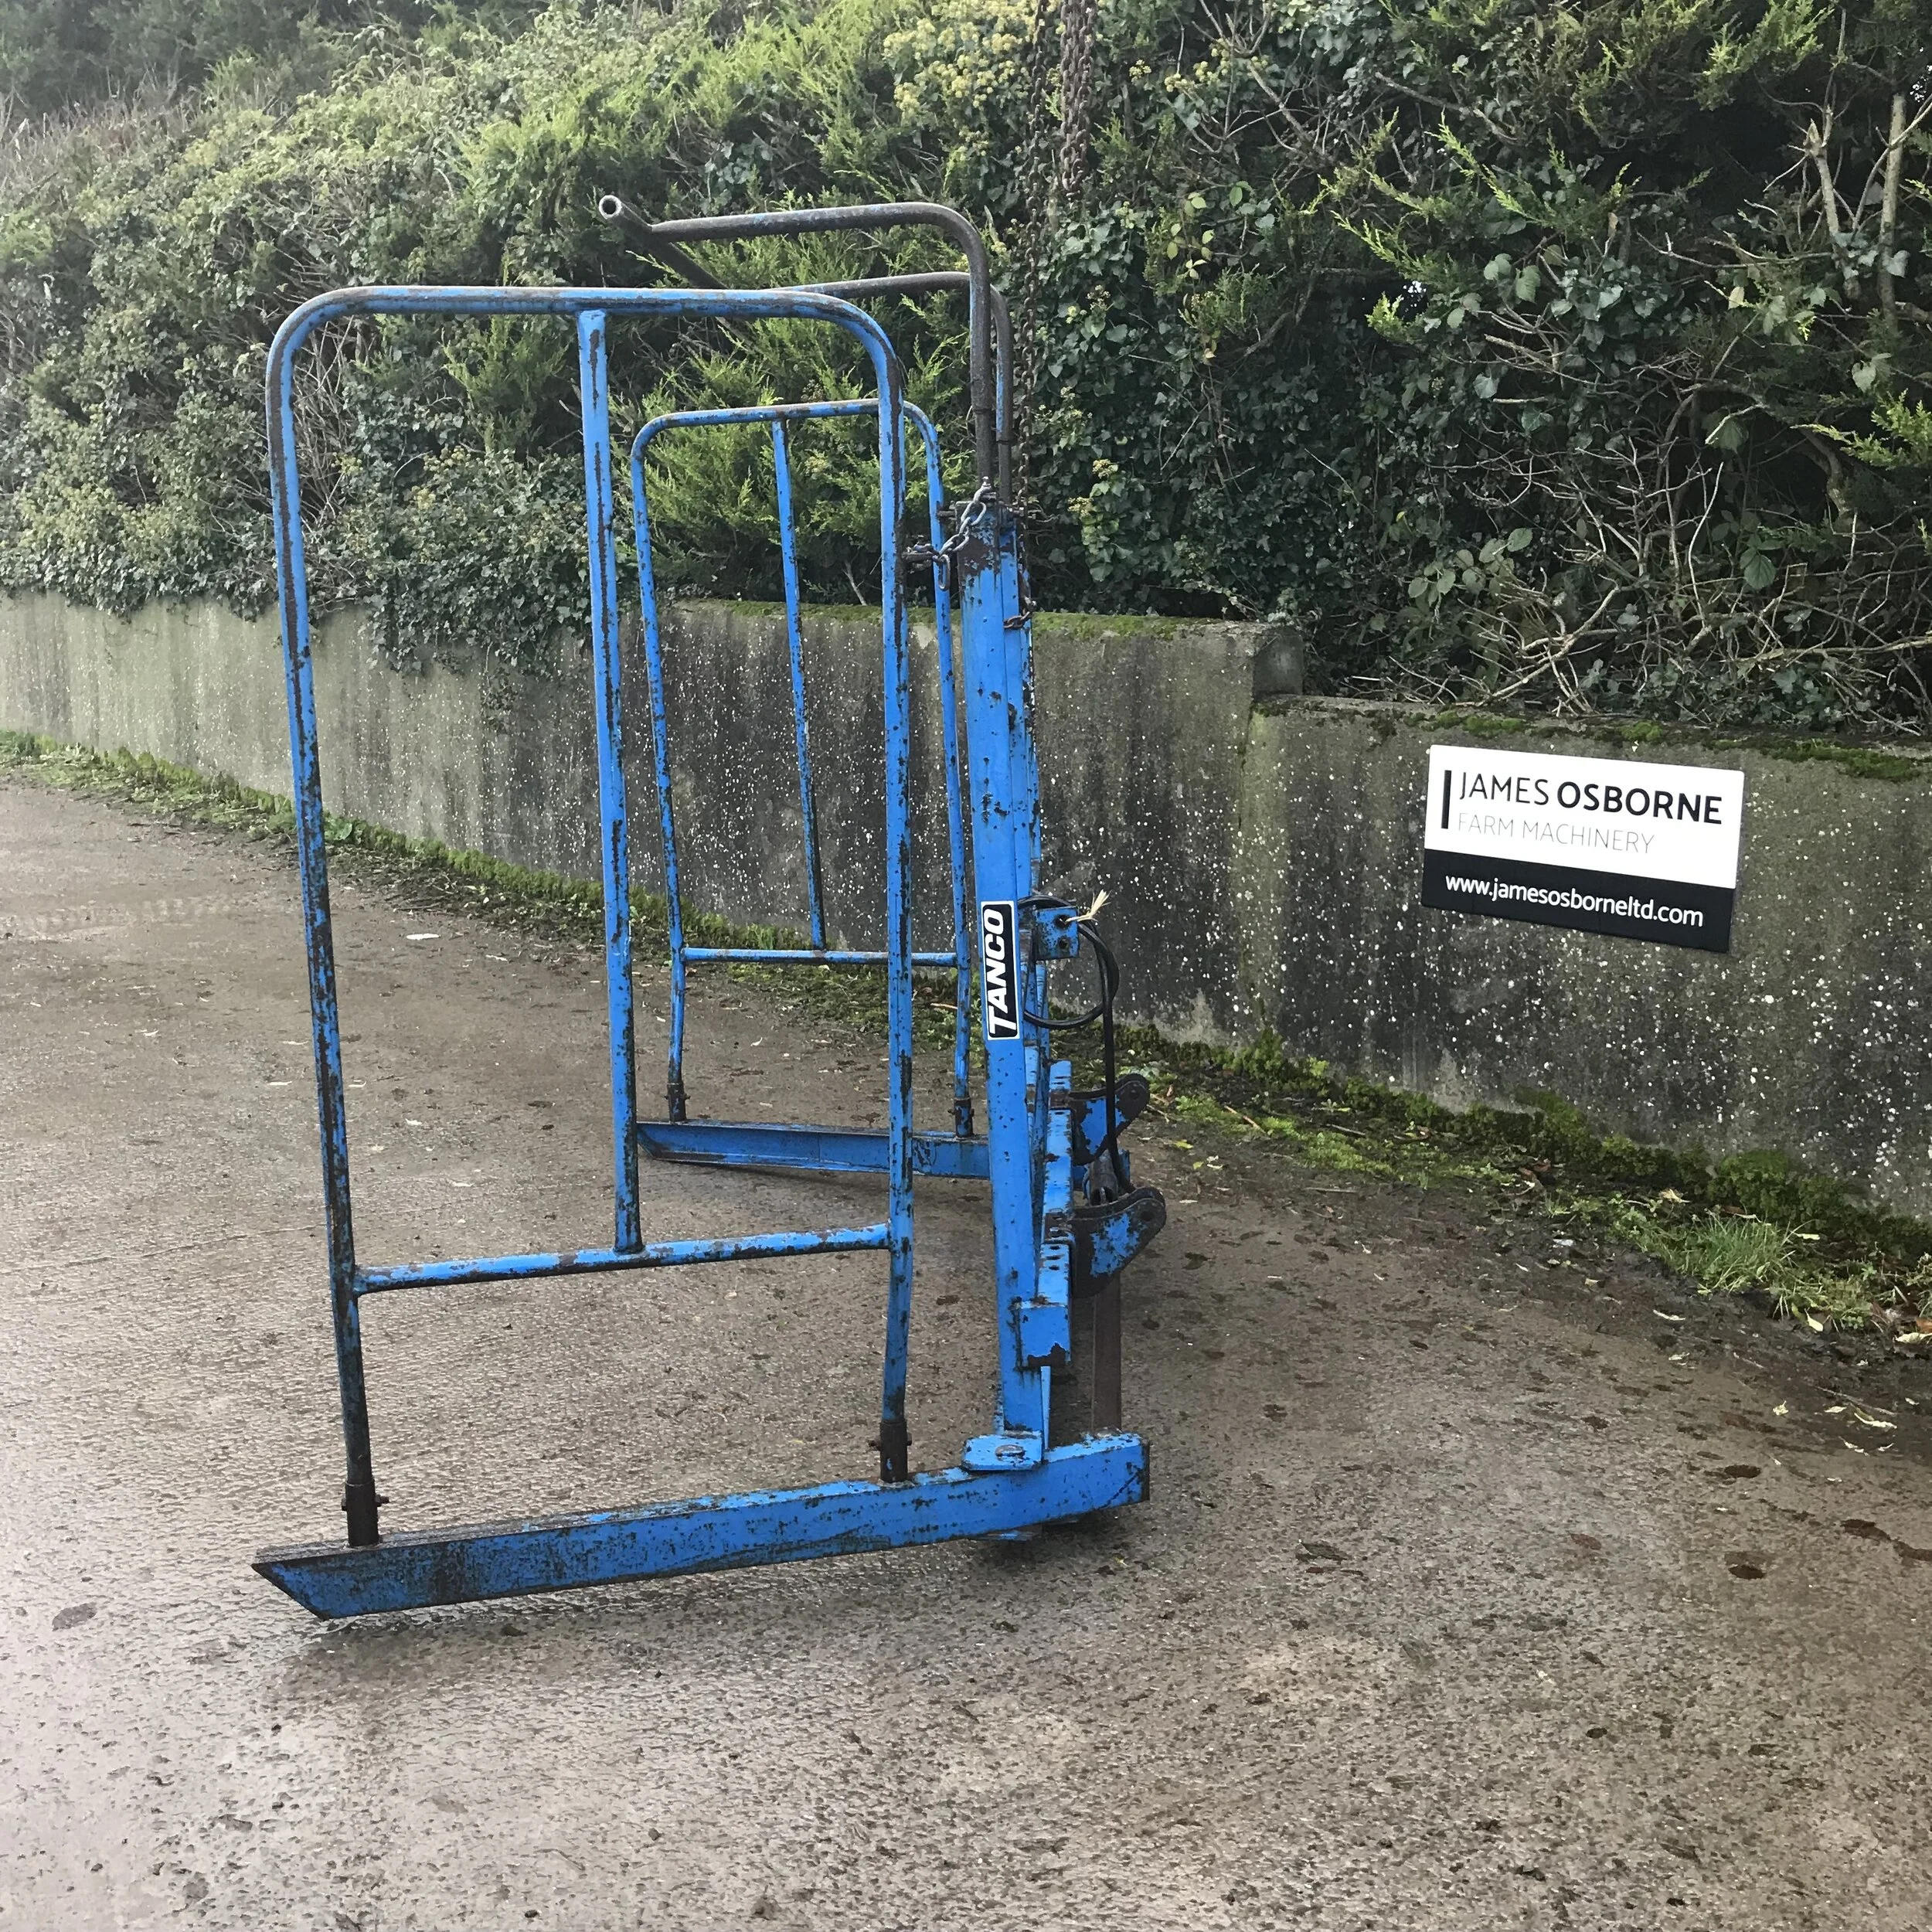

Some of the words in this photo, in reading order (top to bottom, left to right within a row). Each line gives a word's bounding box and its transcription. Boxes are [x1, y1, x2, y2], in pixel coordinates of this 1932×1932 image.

[1459, 771, 1549, 805] JAMES
[1556, 781, 1723, 825] OSBORNE
[1458, 812, 1514, 838] FARM
[1522, 820, 1655, 854] MACHINERY
[1445, 875, 1703, 927] www.jamesosborneltd.com
[983, 908, 1017, 1034] TANCO
